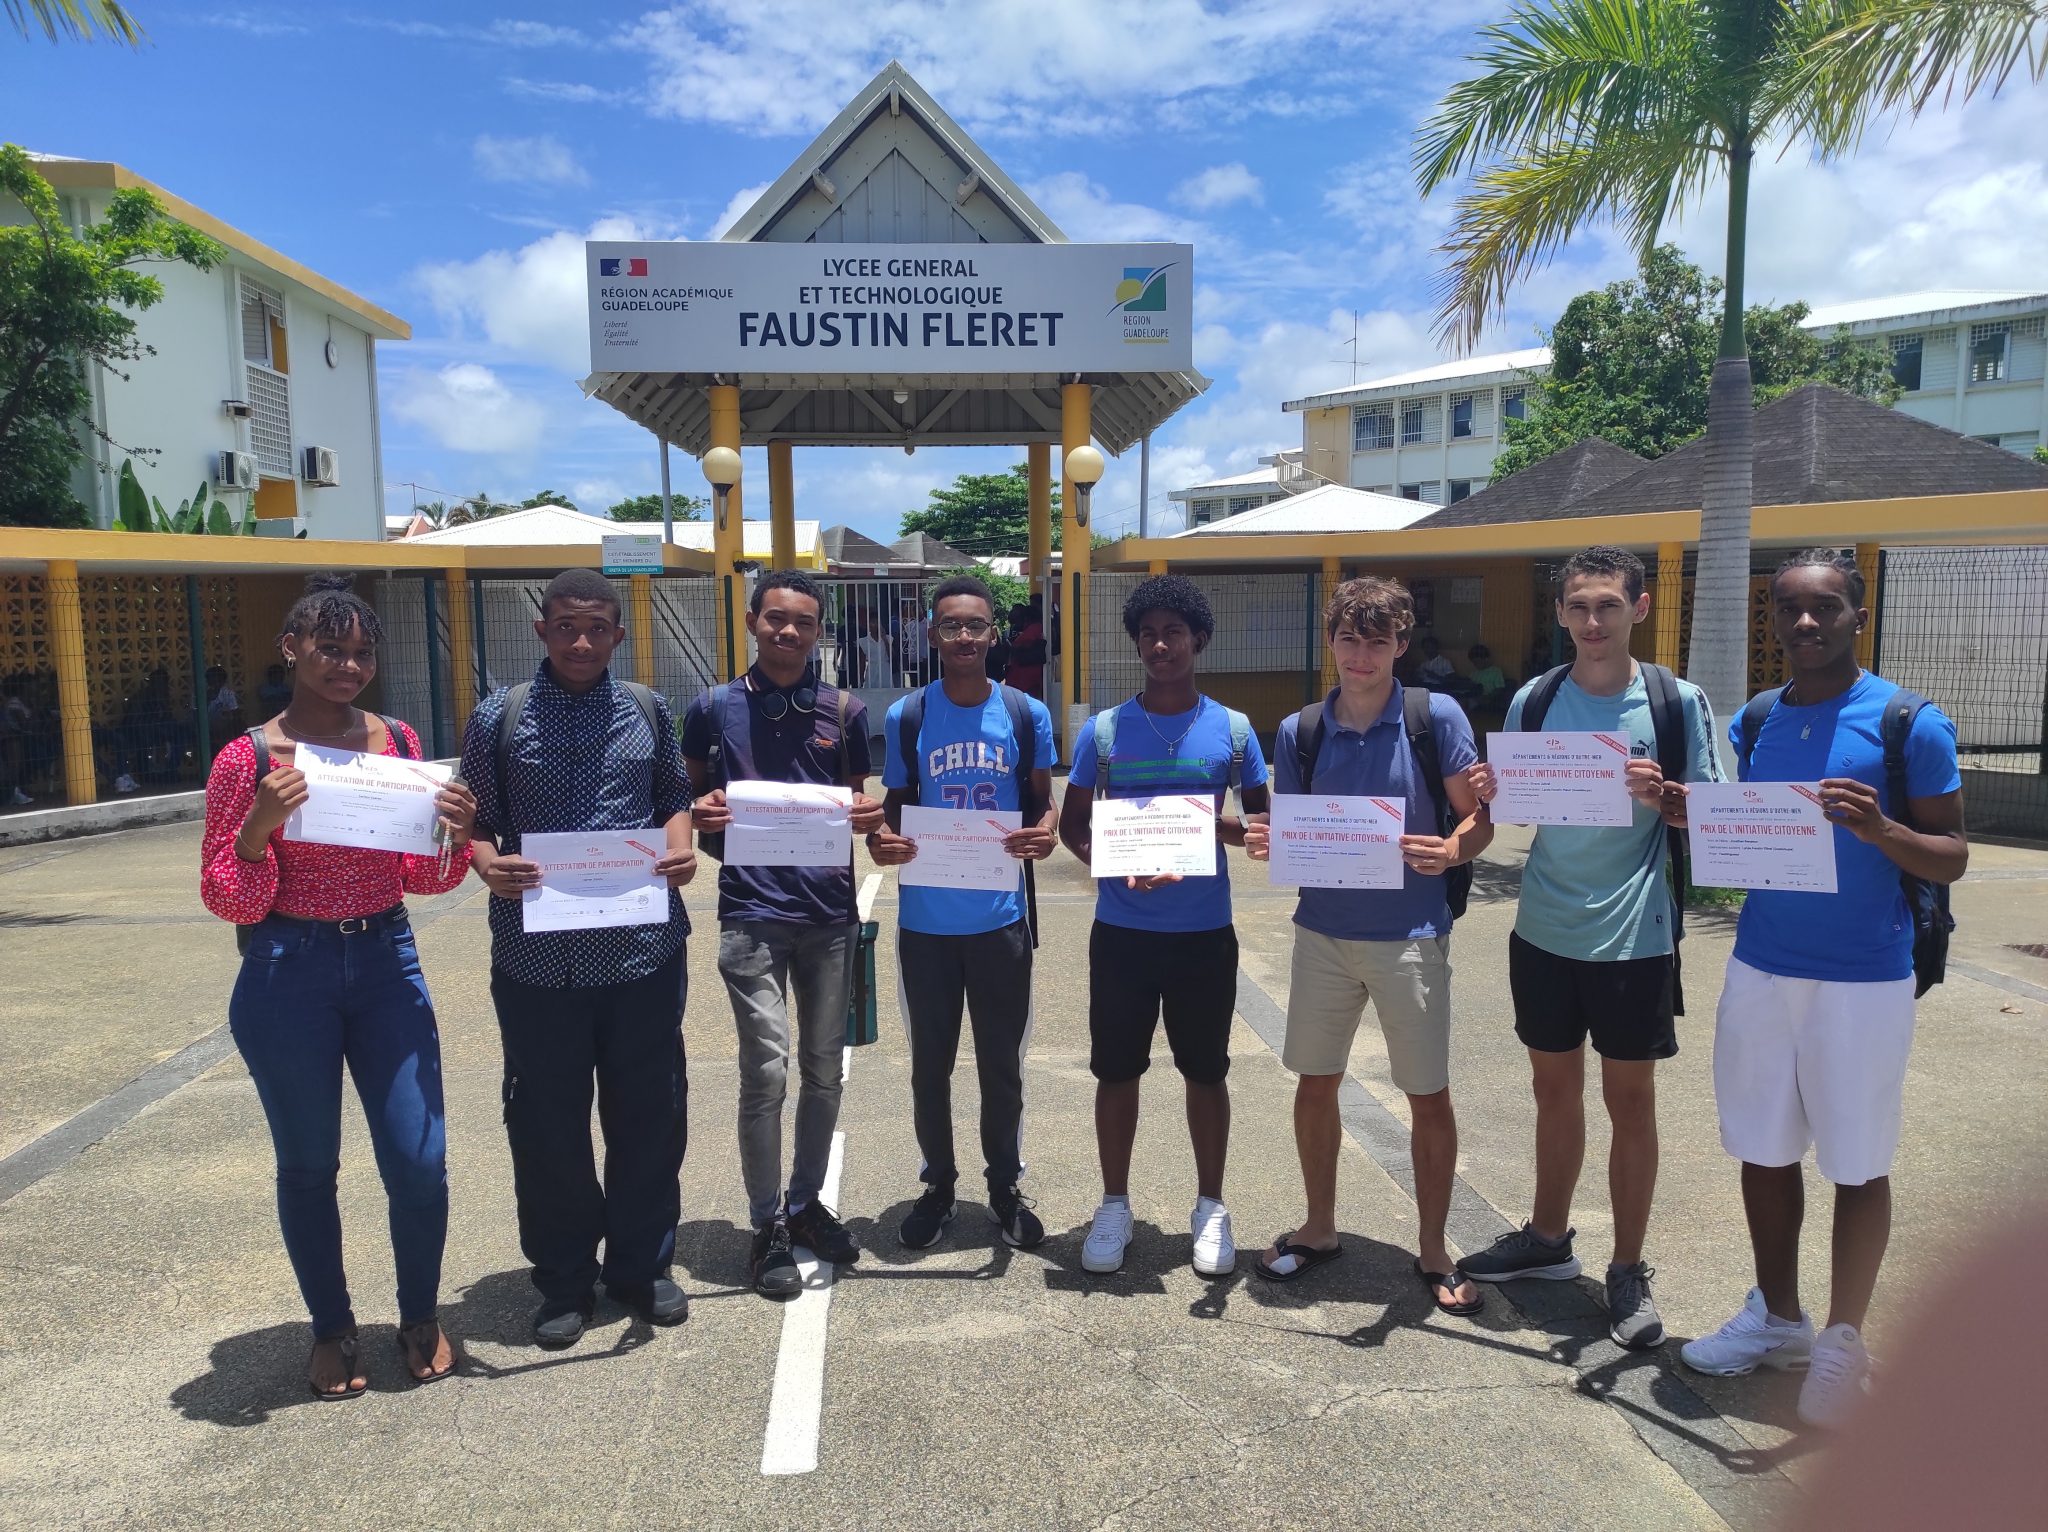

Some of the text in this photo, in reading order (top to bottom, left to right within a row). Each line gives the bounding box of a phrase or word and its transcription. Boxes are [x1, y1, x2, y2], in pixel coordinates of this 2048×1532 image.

[823, 259, 978, 277] LYCEE GENERAL
[601, 286, 734, 300] RÉGION ACADÉMIQUE
[800, 286, 1003, 308] ET TECHNOLOGIQUE
[602, 301, 689, 311] GUADELOUPE
[604, 320, 628, 328] Liberté
[1124, 316, 1151, 325] REGION
[604, 329, 629, 338] Égalité
[739, 312, 1064, 347] FAUSTIN FLERET
[1123, 328, 1169, 338] GUADELOUPE
[604, 338, 638, 346] Fraternité
[929, 741, 1010, 777] CHILL
[1501, 769, 1616, 779] PRIX DE L'INITIATIVE CITOYENNE
[317, 774, 365, 786] ATTESTATION
[366, 779, 375, 787] DE
[376, 781, 427, 793] PARTICIPATION
[1129, 827, 1166, 836] L'INITIATIVE
[1167, 826, 1202, 835] CITOYENNE
[1700, 824, 1816, 836] PRIX DE L'INITIATIVE CITOYENNE
[1282, 831, 1389, 843] PRIX DE L'INITIATIVE CITOYENNE
[544, 860, 644, 871] ATTESTATION DE PARTICIPATION
